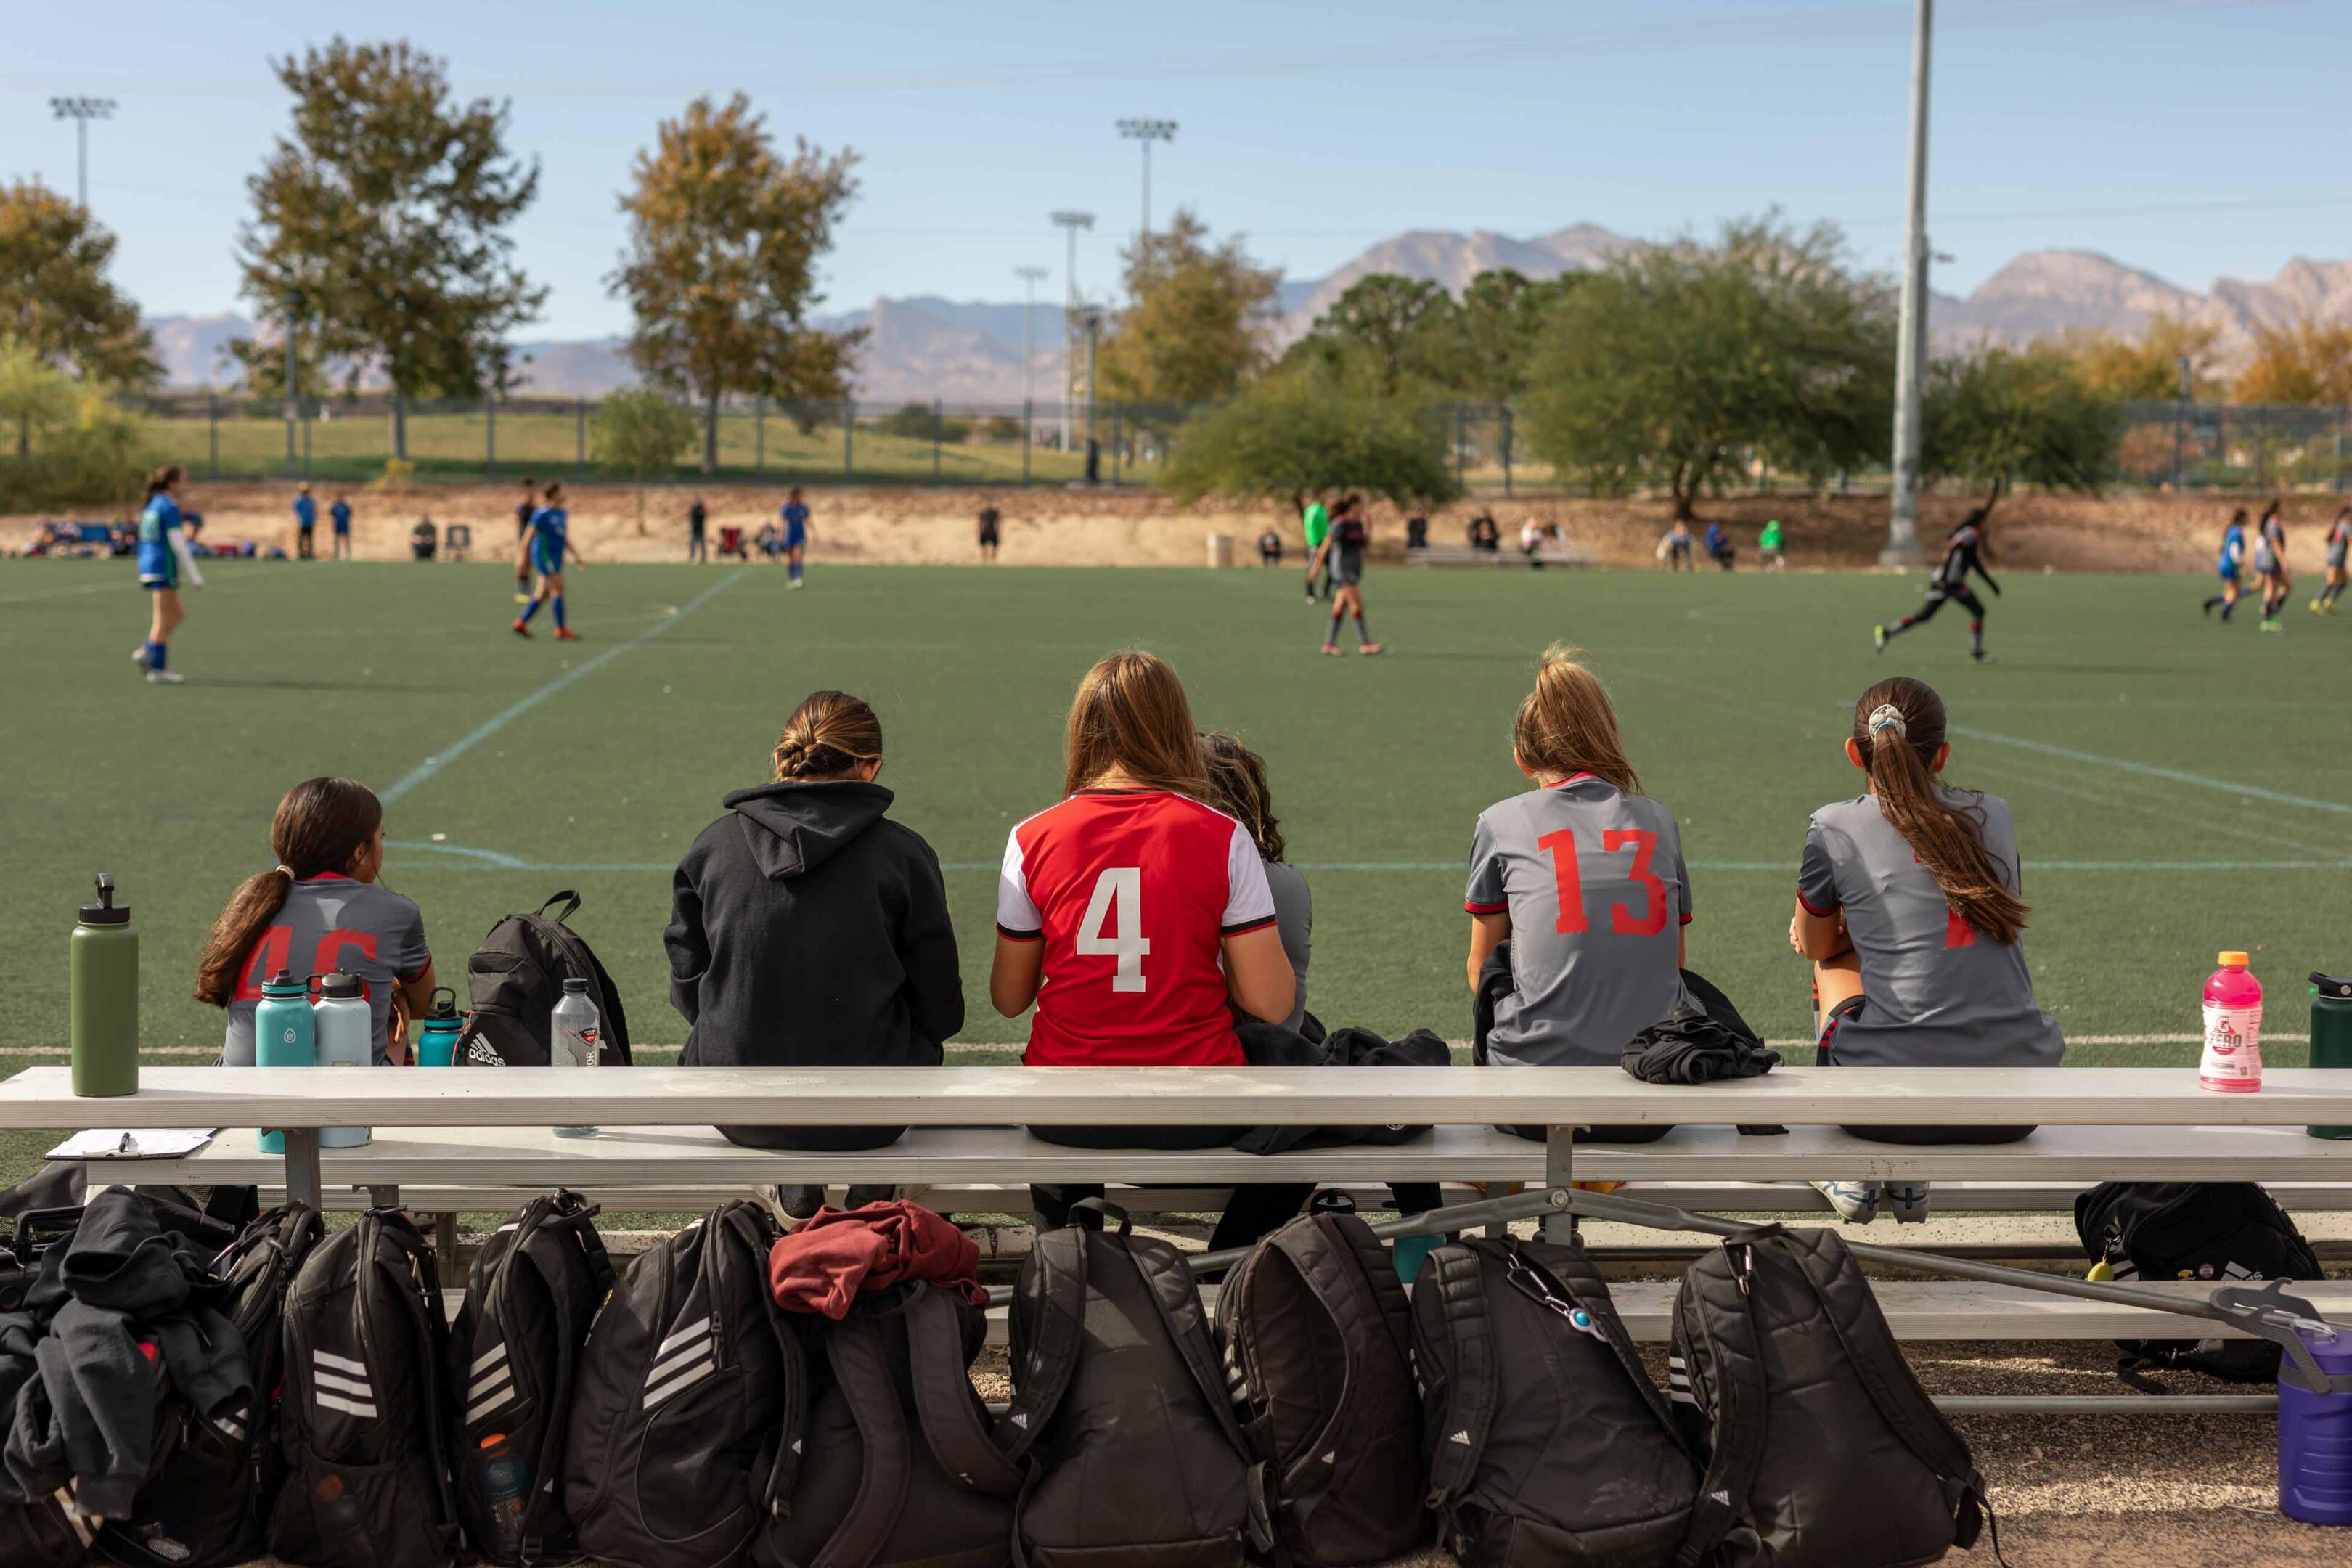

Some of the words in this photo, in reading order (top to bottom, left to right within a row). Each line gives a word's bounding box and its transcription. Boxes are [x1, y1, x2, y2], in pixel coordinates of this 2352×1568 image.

[1538, 828, 1667, 936] 13
[1076, 867, 1150, 992] 4
[2208, 1033, 2242, 1048] ZERO
[468, 1048, 506, 1067] adidas
[586, 1051, 595, 1067] OR
